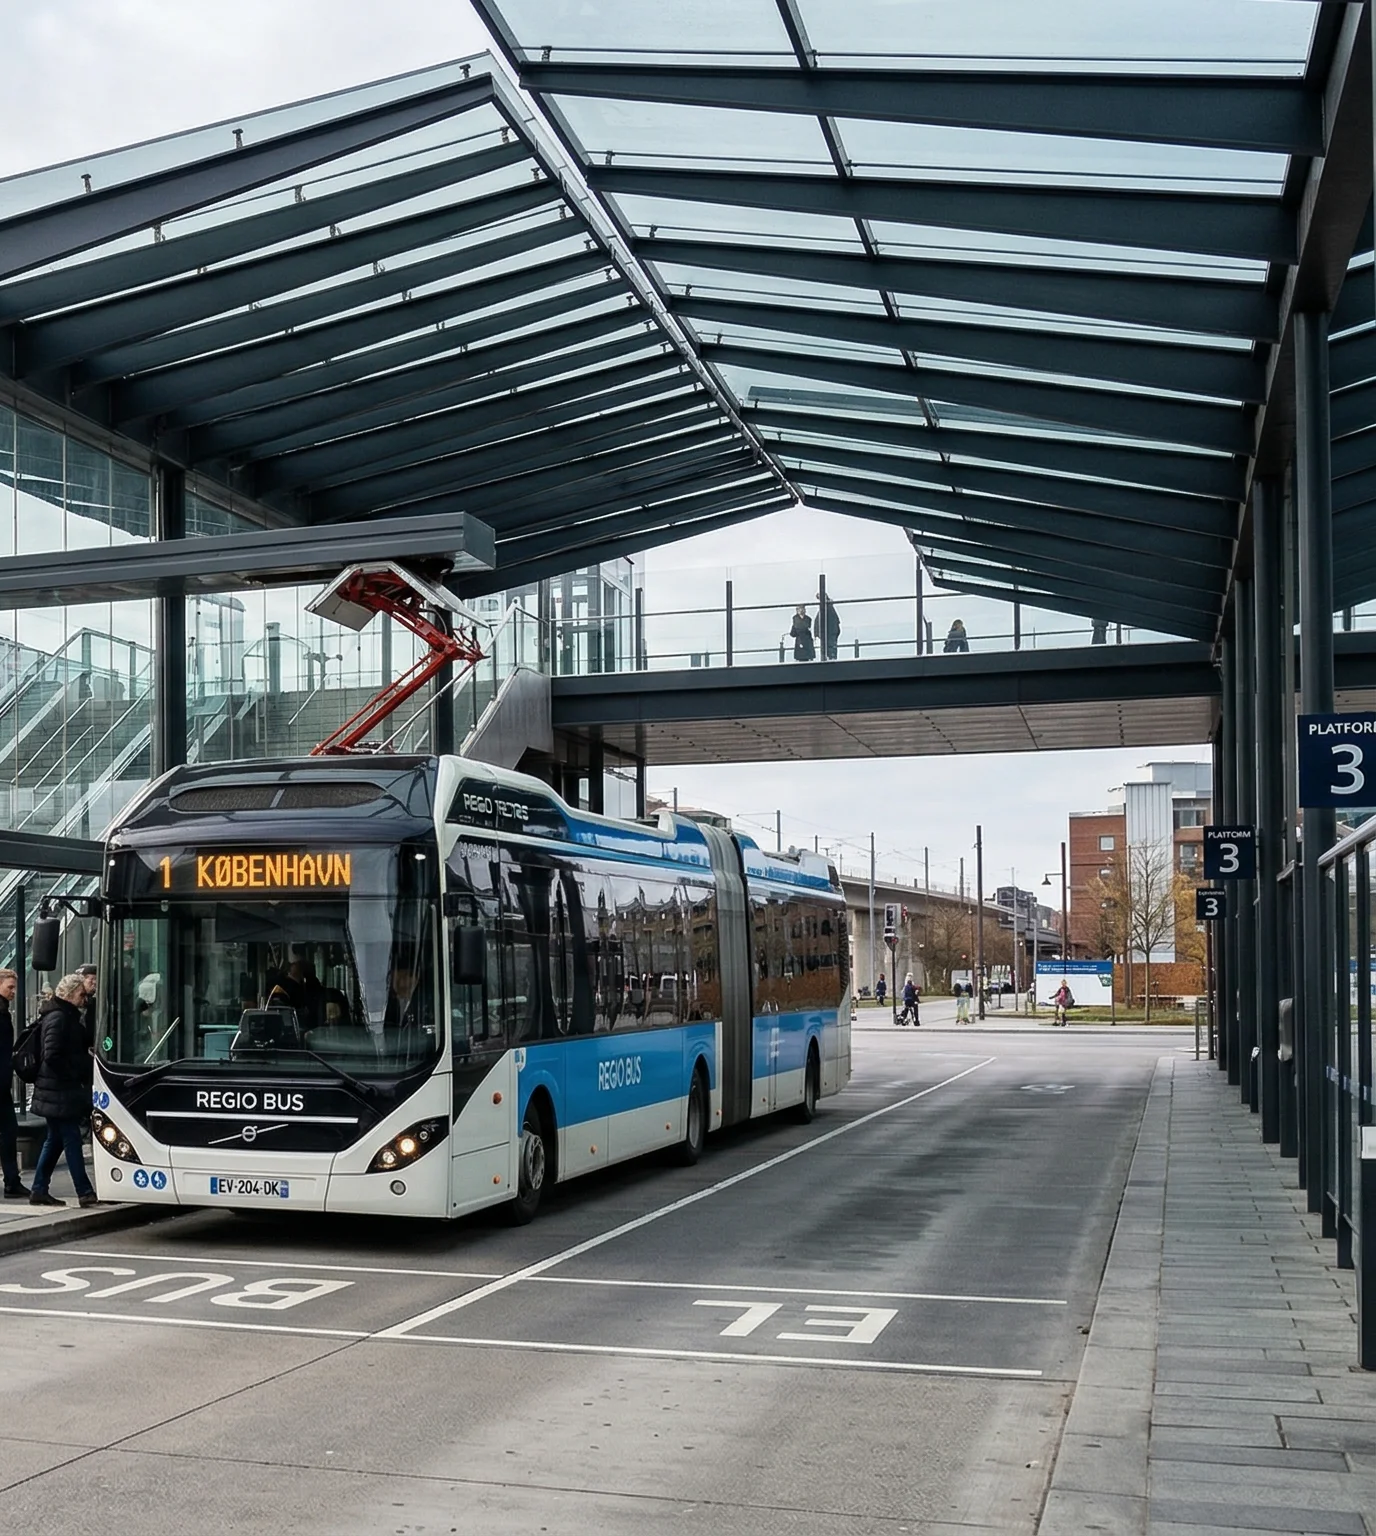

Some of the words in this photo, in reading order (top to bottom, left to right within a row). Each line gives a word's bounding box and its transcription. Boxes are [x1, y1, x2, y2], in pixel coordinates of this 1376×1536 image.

[1308, 721, 1376, 735] PLATFOR
[1330, 743, 1365, 795] 3
[159, 856, 171, 889] 1
[197, 853, 351, 888] KØBENHAVN
[1219, 843, 1240, 873] 3
[1205, 898, 1218, 916] 3
[599, 1058, 625, 1091] REGIO
[625, 1056, 642, 1085] BUS
[196, 1091, 258, 1109] REGIO
[263, 1093, 304, 1111] BUS
[692, 1300, 899, 1344] EL
